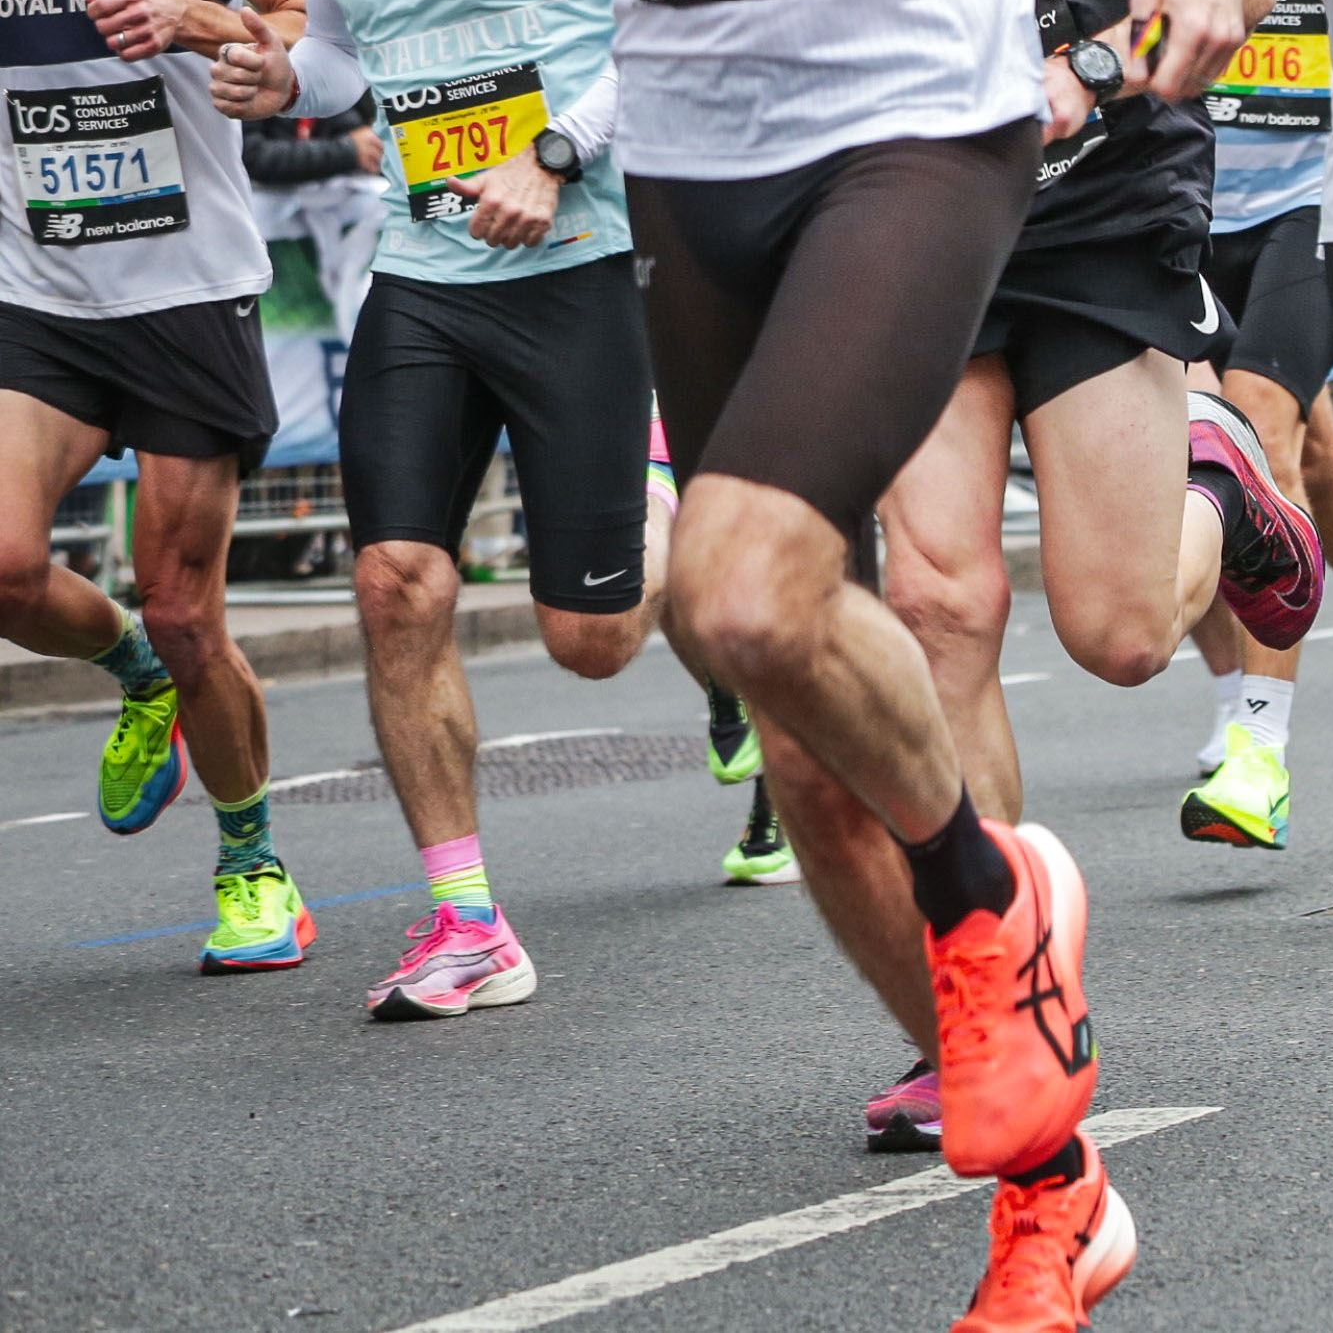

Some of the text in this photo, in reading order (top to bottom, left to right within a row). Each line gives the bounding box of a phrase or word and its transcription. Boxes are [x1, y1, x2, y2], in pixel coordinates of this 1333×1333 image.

[373, 7, 546, 77] VALENCIA
[1230, 45, 1301, 81] 016
[71, 95, 107, 107] TATA
[447, 80, 497, 102] SERVICES
[14, 99, 71, 133] tcs
[75, 99, 157, 118] CONSULTANCY
[1240, 113, 1265, 124] new
[1267, 111, 1320, 126] balance
[77, 118, 129, 131] SERVICES
[427, 115, 509, 172] 2797
[40, 147, 150, 195] 51571
[85, 222, 114, 238] new
[116, 215, 174, 235] balance
